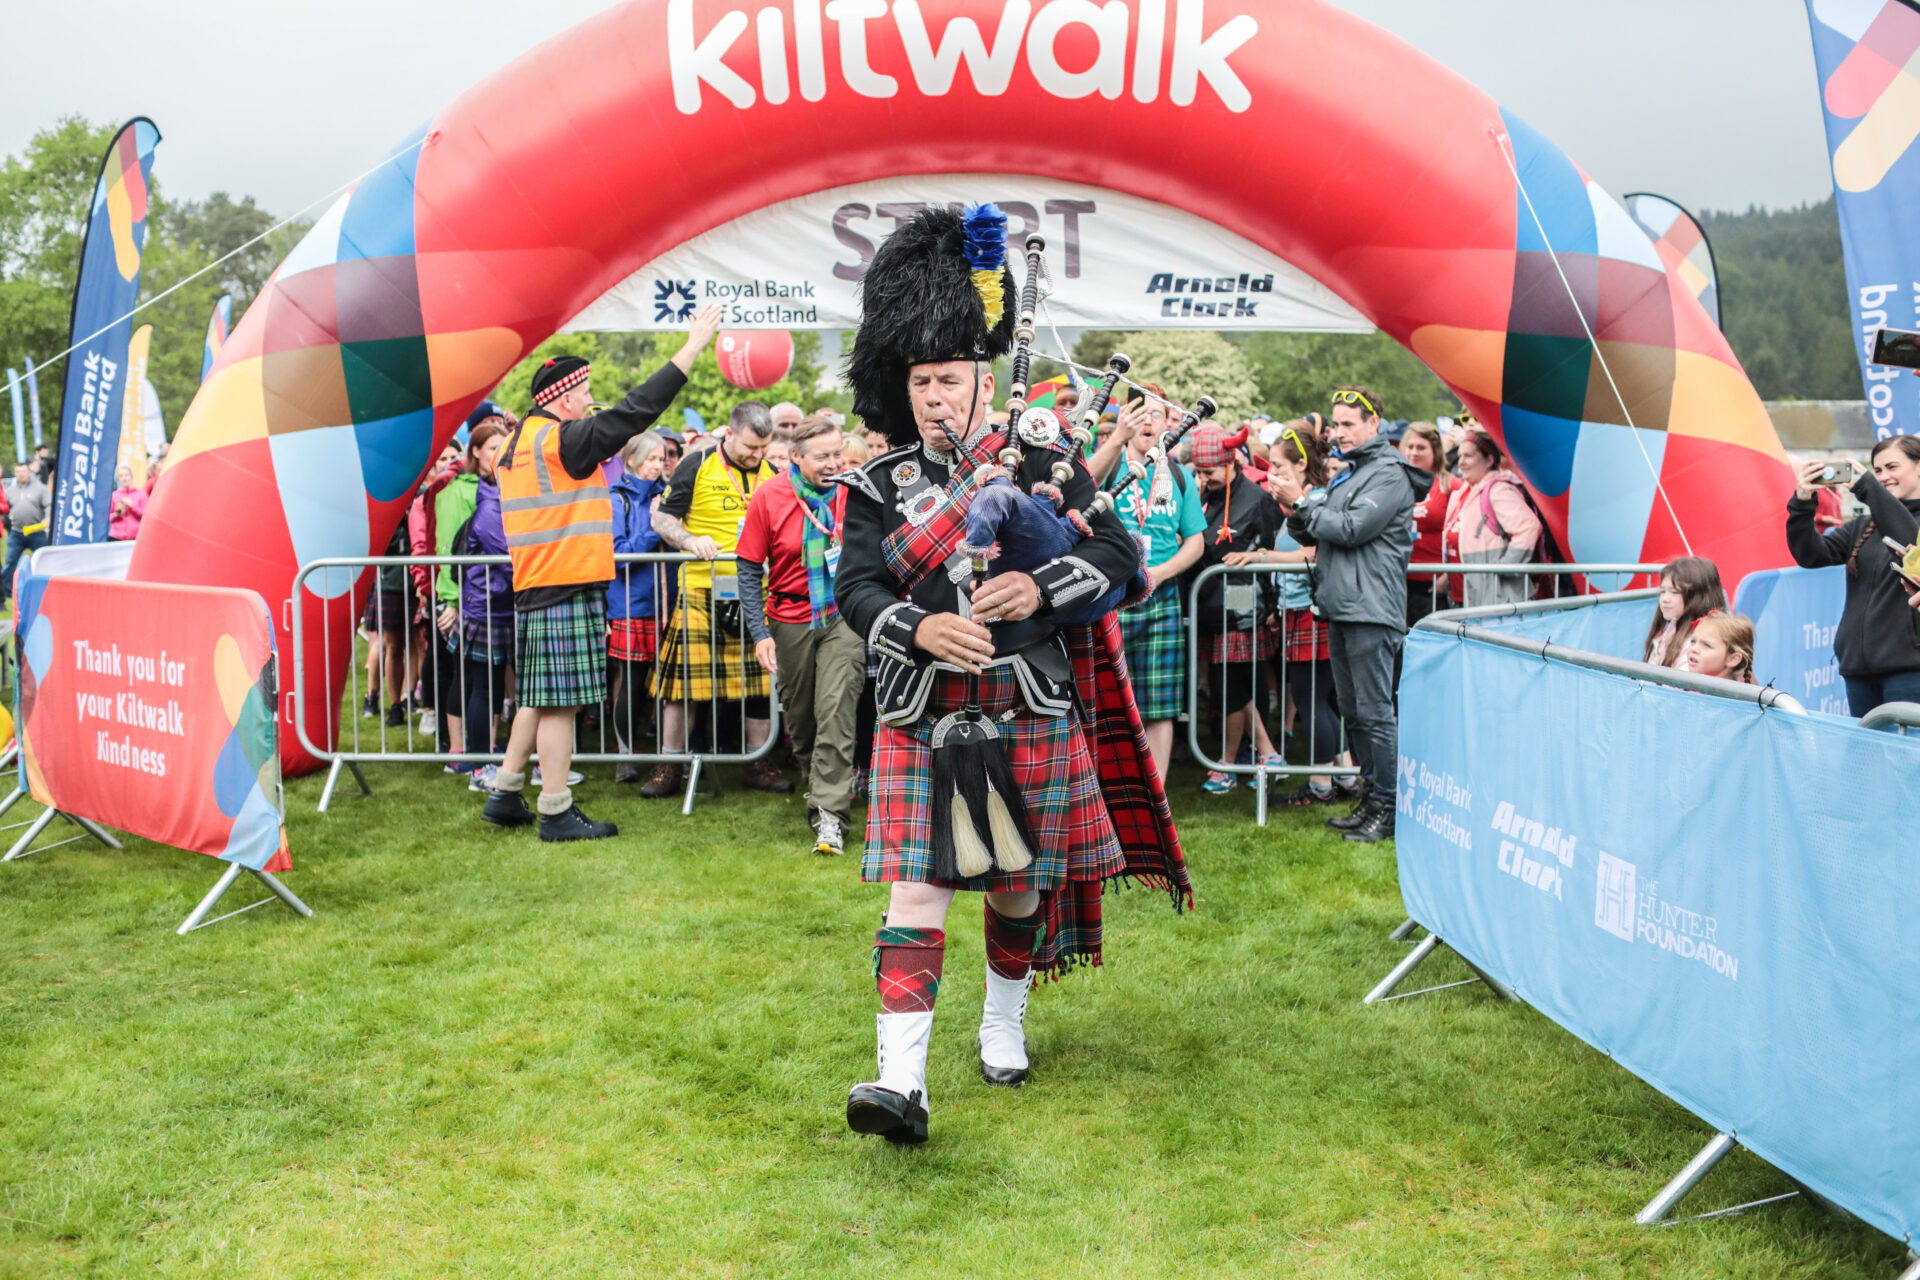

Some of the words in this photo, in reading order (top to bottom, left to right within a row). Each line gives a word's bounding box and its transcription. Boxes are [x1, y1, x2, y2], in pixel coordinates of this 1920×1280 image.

[668, 0, 1259, 114] kiltwalk
[705, 279, 760, 303] Royal
[765, 280, 816, 298] Bank
[1145, 272, 1274, 293] Arnold
[731, 304, 817, 323] Scotland
[1161, 297, 1259, 317] Clark
[74, 350, 101, 437] Bank
[84, 357, 118, 501] Scotland
[64, 442, 90, 538] Royal
[73, 639, 122, 677] Thank
[126, 654, 155, 686] you
[160, 650, 185, 687] for
[1804, 663, 1840, 698] your
[76, 691, 112, 723] your
[116, 691, 184, 737] Kiltwalk
[97, 730, 165, 776] Kindness
[1418, 761, 1446, 800] Royal
[1446, 773, 1472, 813] Bank
[1416, 800, 1428, 825] of
[1426, 803, 1472, 851] Scotland
[1639, 875, 1660, 896] THE
[1637, 892, 1718, 943] HUNTER
[1636, 917, 1739, 981] FOUNDATION
